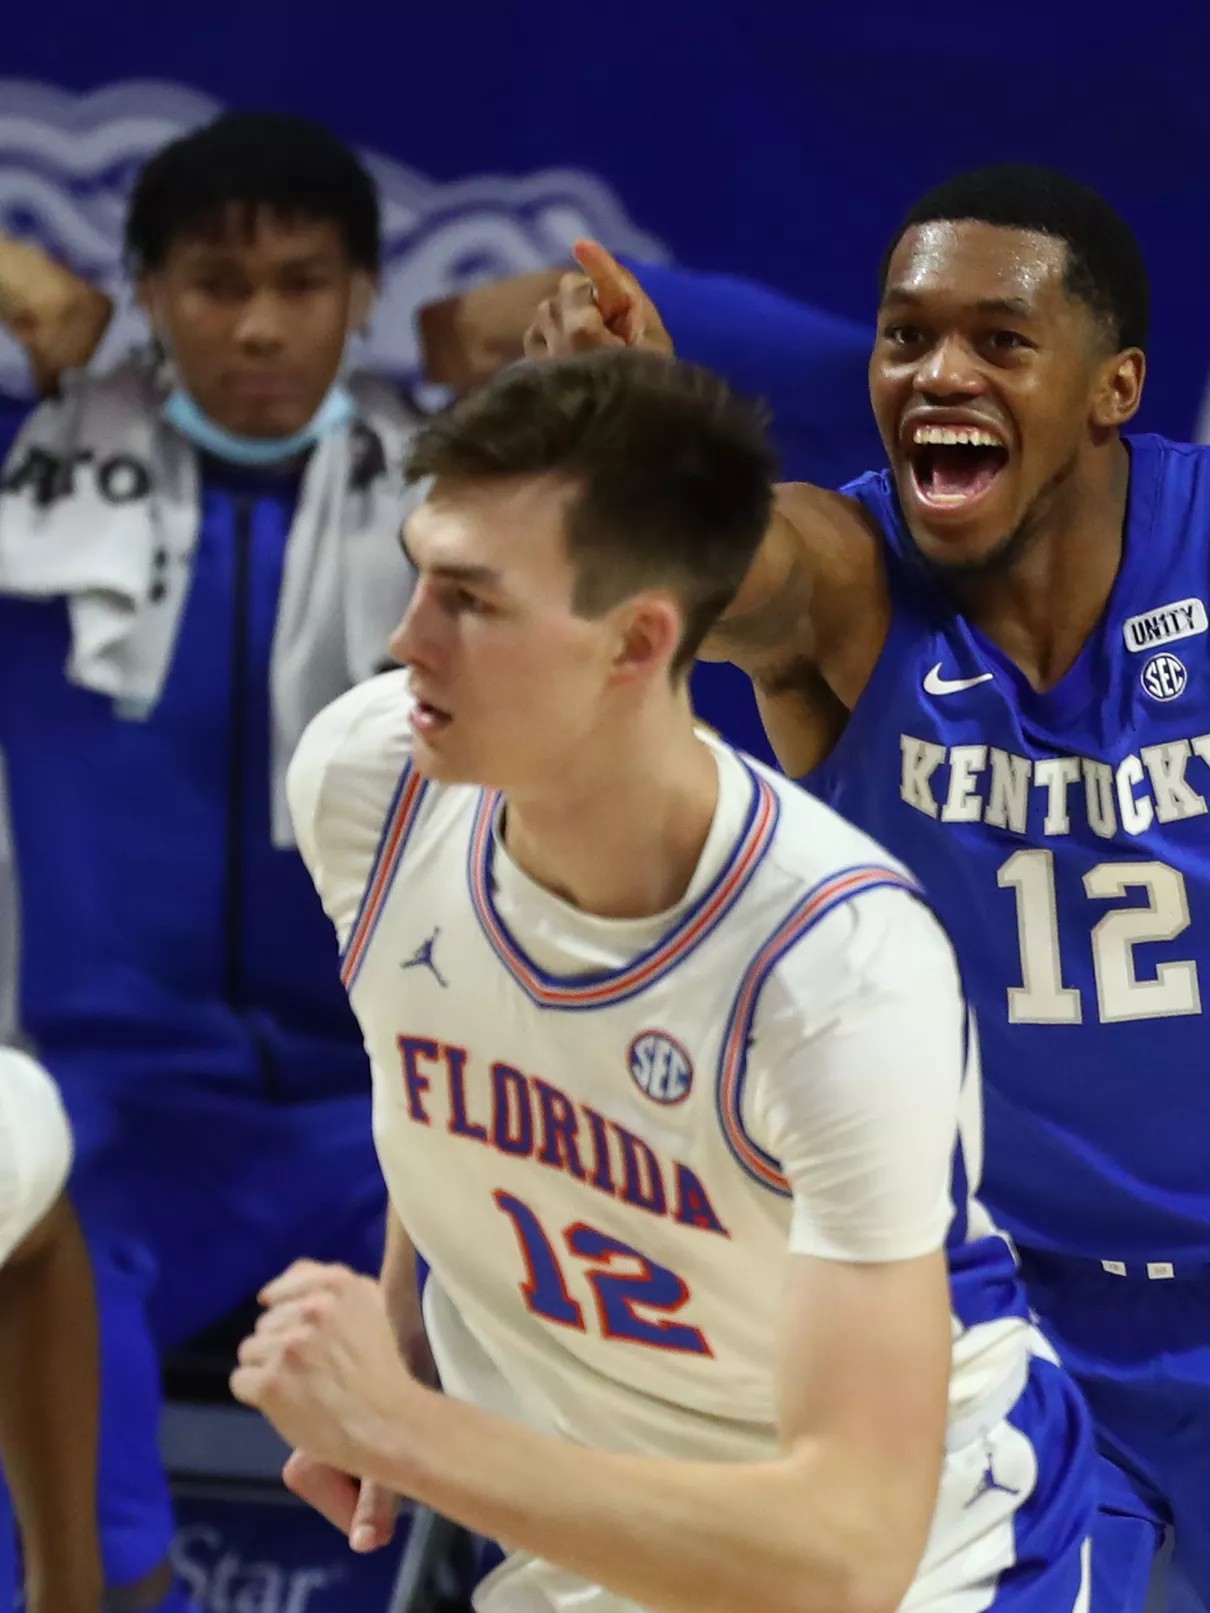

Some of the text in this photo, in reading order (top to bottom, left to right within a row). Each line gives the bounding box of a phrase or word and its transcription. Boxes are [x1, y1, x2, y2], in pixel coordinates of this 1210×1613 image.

[1143, 656, 1184, 698] SEC
[997, 848, 1202, 1025] 12
[397, 1033, 732, 1240] FLORIDA
[632, 1036, 690, 1100] SEC
[491, 1188, 715, 1358] 12
